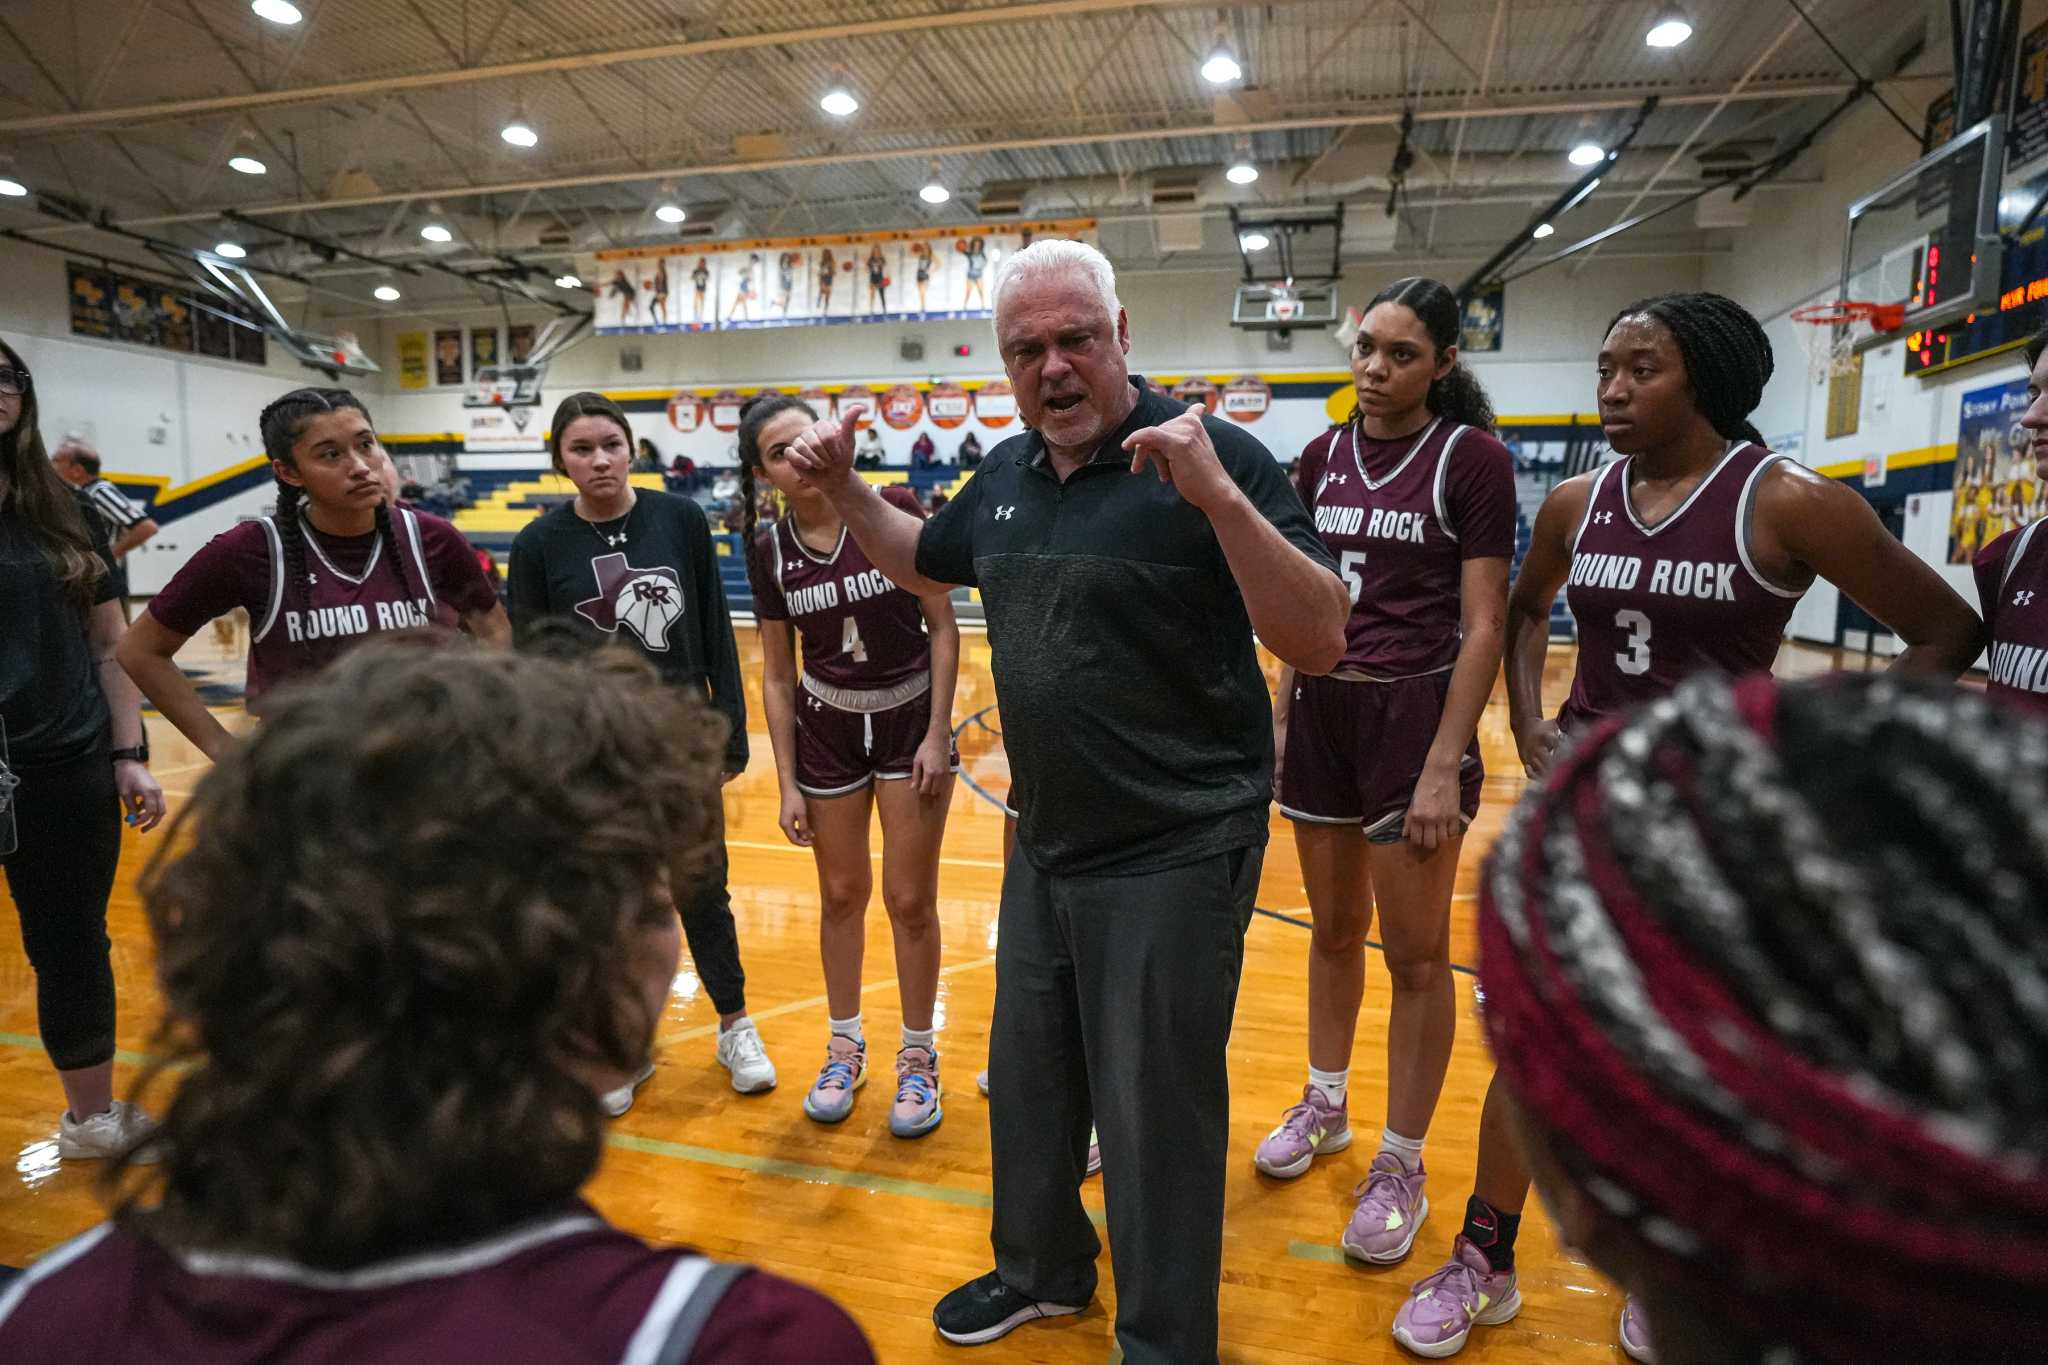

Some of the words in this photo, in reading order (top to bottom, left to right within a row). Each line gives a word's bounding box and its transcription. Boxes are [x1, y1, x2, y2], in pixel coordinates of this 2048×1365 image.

[1367, 508, 1428, 543] ROCK
[786, 581, 838, 617] ROUND
[1341, 550, 1366, 606] 5
[1649, 559, 1738, 601] ROCK
[285, 604, 369, 642] ROUND
[375, 598, 430, 631] ROCK
[841, 615, 868, 663] 4
[1615, 609, 1651, 676] 3
